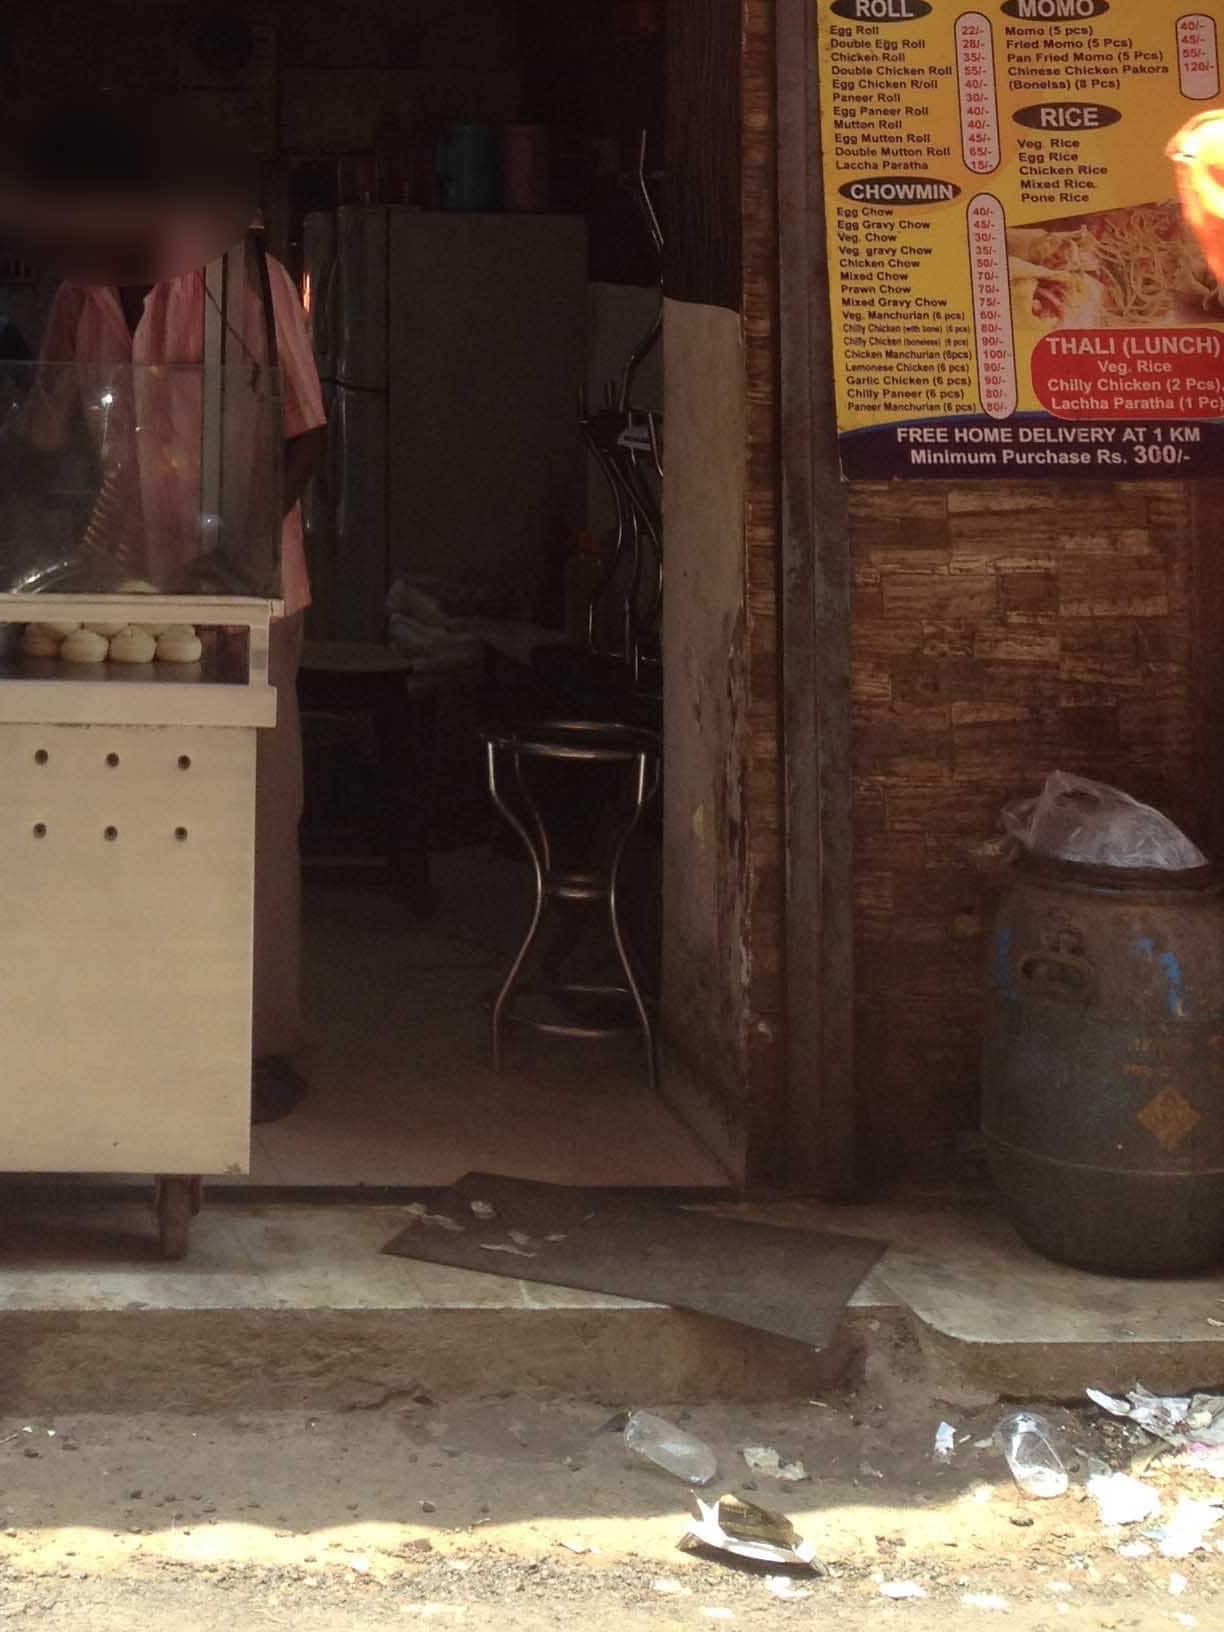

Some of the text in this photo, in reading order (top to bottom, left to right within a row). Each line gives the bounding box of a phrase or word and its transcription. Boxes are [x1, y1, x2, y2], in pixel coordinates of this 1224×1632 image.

[856, 0, 914, 17] ROLL
[830, 26, 852, 37] Egg
[856, 25, 879, 35] Roll
[1005, 27, 1044, 35] Momo
[830, 39, 925, 50] Double Egg Roll
[1006, 40, 1039, 49] Fried
[1043, 40, 1083, 48] Momo
[830, 53, 878, 62] Chicken
[882, 53, 905, 62] Roll
[1007, 54, 1031, 63] Pan
[1036, 53, 1069, 62] Fried
[1073, 52, 1113, 61] Momo
[832, 66, 952, 76] Double Chicken Roll
[1008, 65, 1169, 76] Chinese Chicken Pakora
[832, 80, 855, 90] Egg
[858, 80, 906, 88] Chicken
[833, 94, 873, 102] Paneer
[877, 93, 901, 102] Roll
[833, 107, 856, 117] Egg
[860, 107, 901, 115] Paneer
[905, 107, 928, 115] Roll
[1040, 107, 1099, 127] RICE
[834, 120, 874, 129] Mutton
[879, 120, 902, 129] Roll
[835, 134, 857, 144] Egg
[861, 134, 903, 142] Mutton
[907, 134, 930, 142] Roll
[1050, 139, 1080, 148] Rice
[835, 148, 877, 156] Double
[881, 148, 922, 156] Mutton
[927, 147, 950, 156] Roll
[1019, 152, 1078, 163] Egg Rice
[836, 161, 879, 170] Laccha
[883, 161, 928, 170] Paratha
[1019, 165, 1108, 175] Chicken Rice
[1020, 179, 1060, 189] Mixed
[850, 184, 954, 199] CHOWMIN
[1022, 193, 1089, 203] Pone Rice
[837, 208, 858, 218] Egg
[862, 207, 894, 216] Chow
[837, 220, 930, 231] Egg Gravy Chow
[865, 233, 897, 242] Chow
[900, 246, 932, 255] Chow
[839, 259, 884, 267] Chicken
[888, 259, 920, 267] Chow
[840, 272, 873, 281] Mixed
[877, 272, 908, 281] Chow
[841, 285, 876, 293] Prawn
[879, 285, 911, 293] Chow
[842, 298, 875, 307] Mixed
[878, 298, 911, 308] Gravy
[915, 298, 947, 307] Chow
[1046, 336, 1220, 358] THALI (LUNCH)
[1137, 360, 1172, 372] Rice
[846, 376, 929, 385] Garlic Chicken
[1047, 379, 1092, 393] Chilly
[1097, 379, 1161, 391] Chicken
[1166, 379, 1181, 393] (2
[883, 389, 922, 398] Paneer
[1052, 398, 1109, 410] Lachha
[1114, 397, 1174, 409] Paratha
[897, 427, 1201, 443] FREE HOME DELIVERY AT 1 KM
[911, 445, 1191, 465] Minimum Purchase Rs. 300/-
